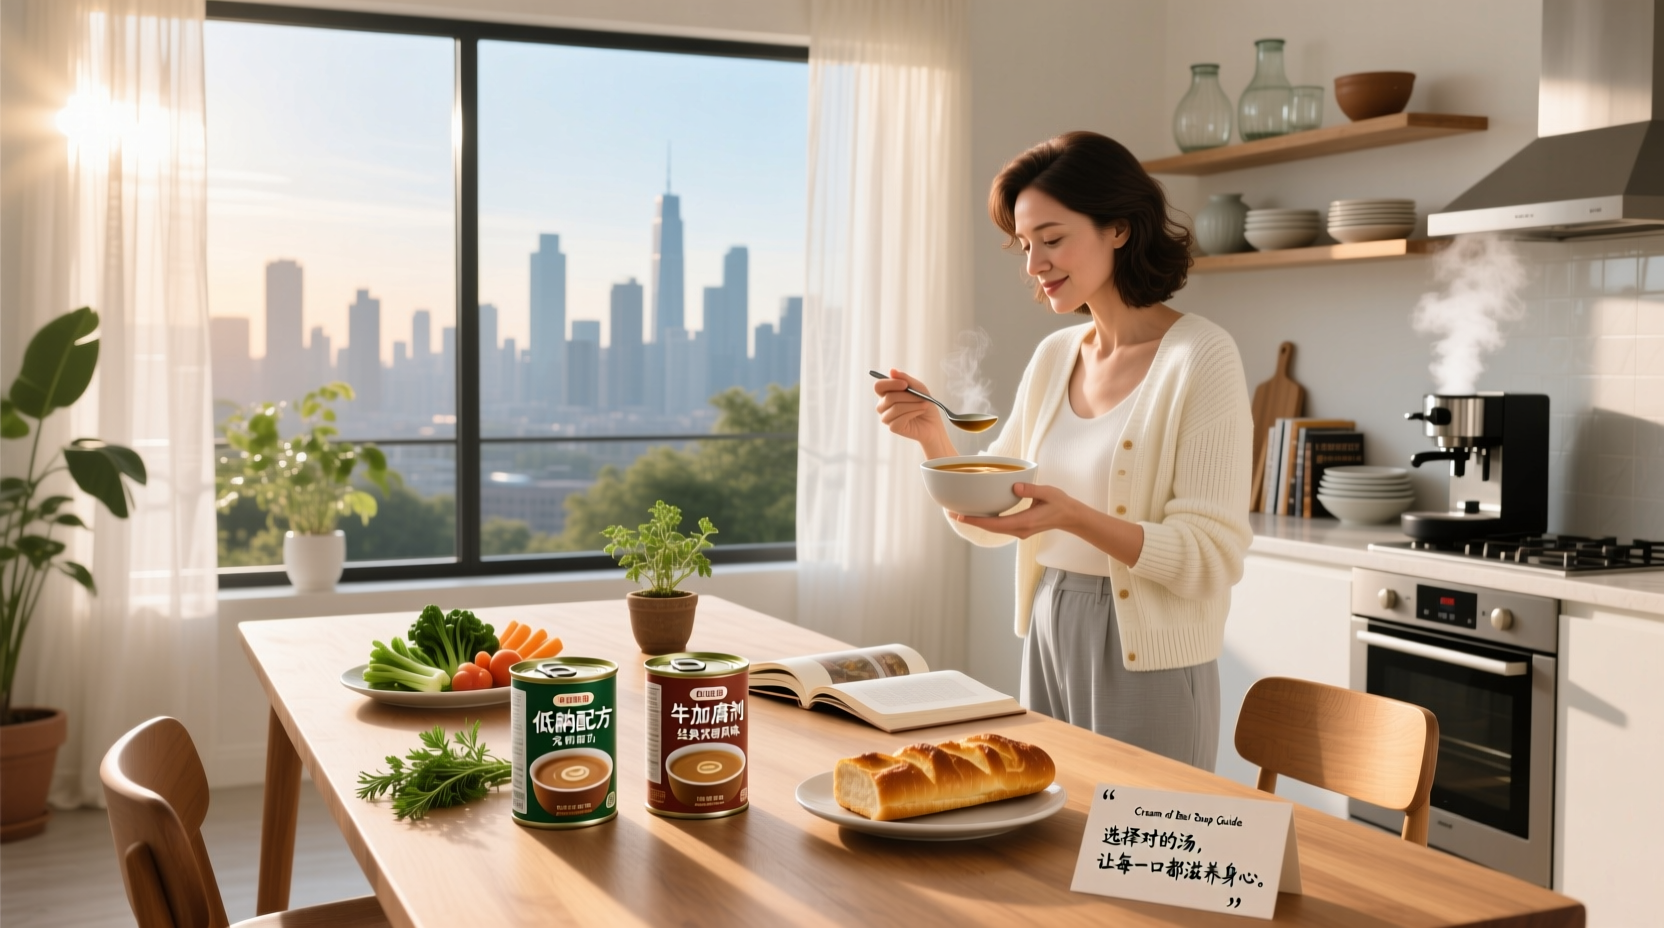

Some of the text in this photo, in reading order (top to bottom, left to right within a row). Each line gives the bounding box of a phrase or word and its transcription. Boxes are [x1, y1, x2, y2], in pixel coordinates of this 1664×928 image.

[1096, 851, 1264, 888] 让每一口都滋养身心。
